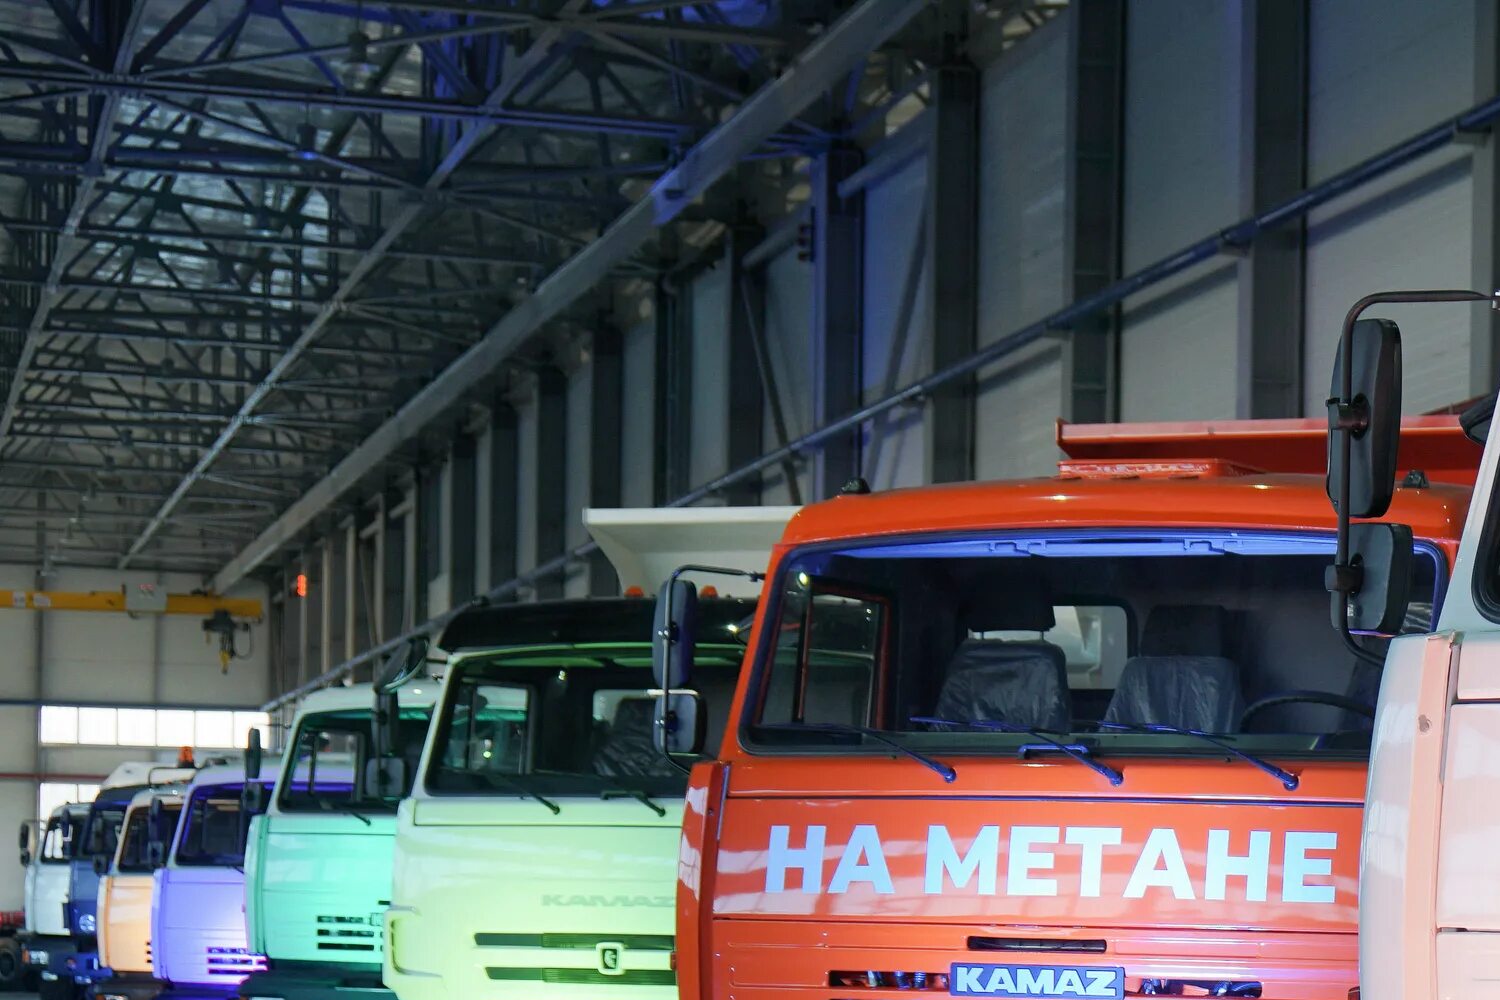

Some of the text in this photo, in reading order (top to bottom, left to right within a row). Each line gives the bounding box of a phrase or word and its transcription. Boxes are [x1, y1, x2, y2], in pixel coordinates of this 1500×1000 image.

[765, 824, 1337, 903] НА МЕТАНЕ
[956, 966, 1117, 997] KAMAZ
